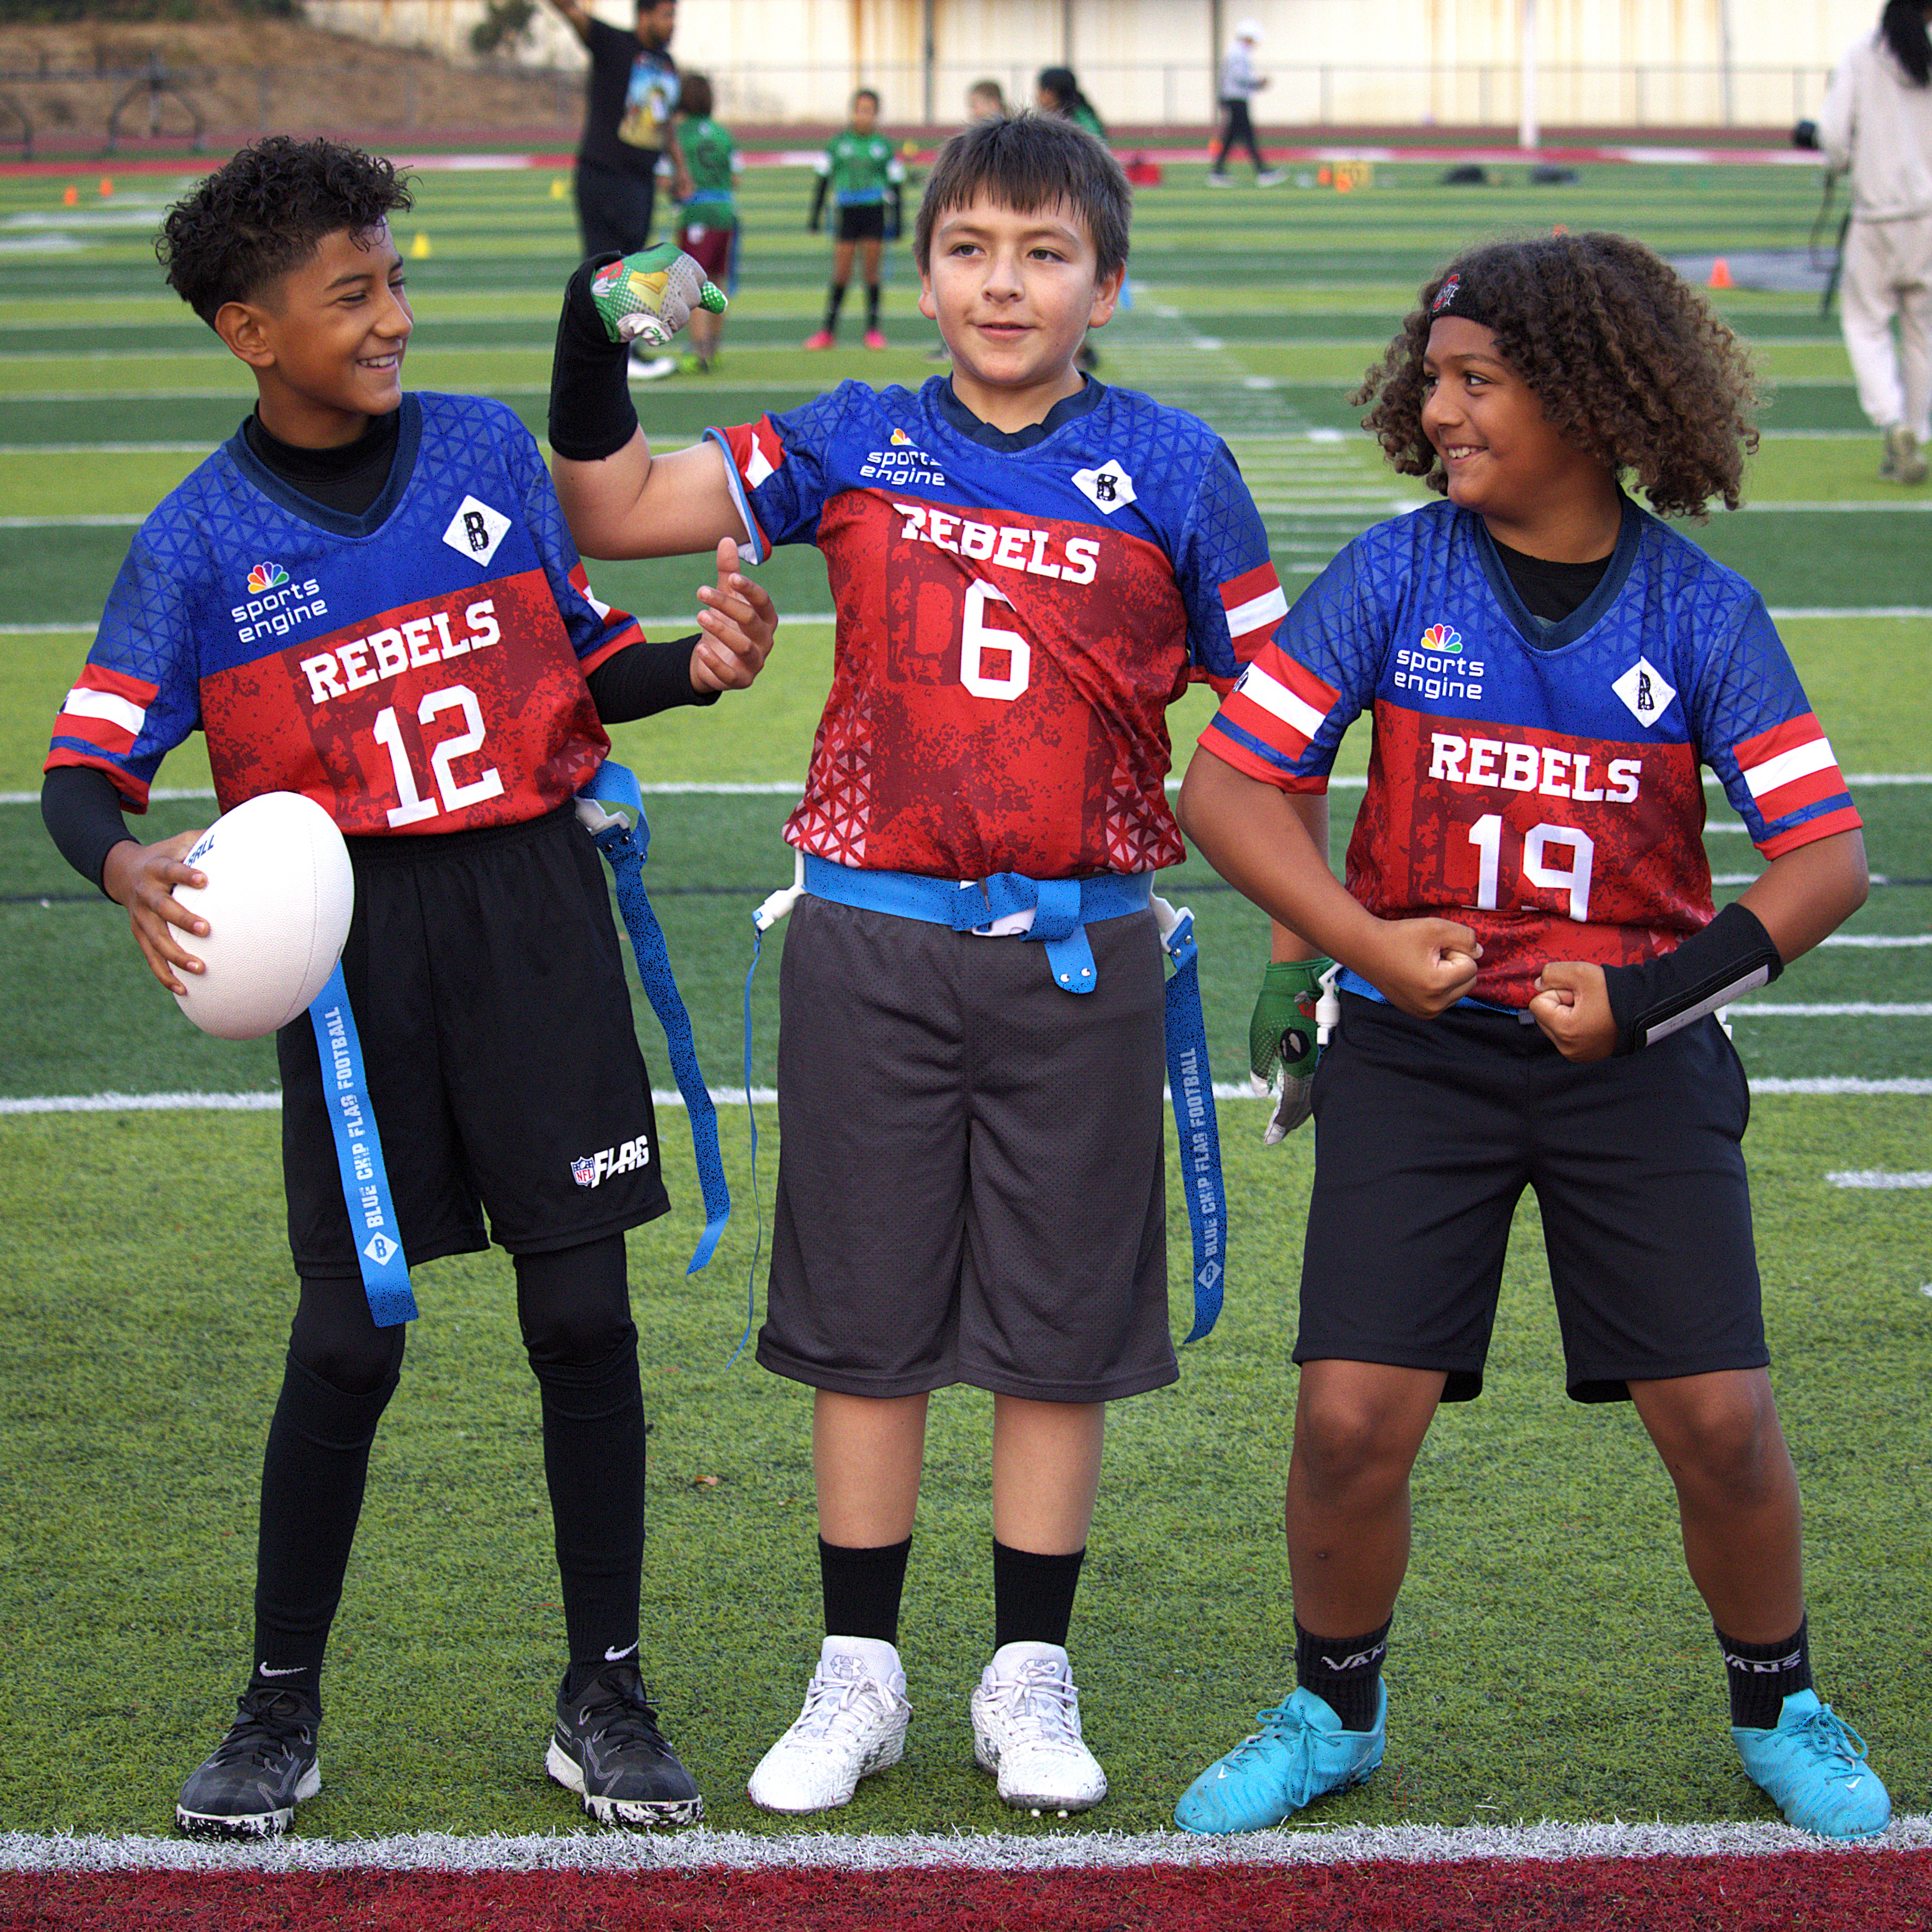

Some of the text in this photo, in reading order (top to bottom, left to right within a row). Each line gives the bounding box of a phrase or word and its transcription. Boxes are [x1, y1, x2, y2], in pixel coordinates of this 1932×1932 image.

[860, 465, 945, 486] engine
[1097, 473, 1118, 501] B
[463, 510, 489, 552] B
[892, 503, 1100, 585] REBELS
[231, 577, 320, 623] sports
[238, 599, 328, 643] engine
[299, 599, 501, 704] REBELS
[960, 578, 1031, 701] 6
[1397, 649, 1485, 677] sports
[1394, 670, 1483, 700] engine
[1638, 670, 1654, 710] B
[372, 684, 505, 828] 12
[1428, 733, 1642, 803] REBELS
[1461, 814, 1594, 922] 19
[325, 1007, 384, 1229] BLUE CHIP FLAG FOOTBALL
[575, 1135, 649, 1189] NFL FLAG
[1180, 1047, 1219, 1257] BLUE CHIP FLAG FOOTBALL
[374, 1238, 387, 1259] B
